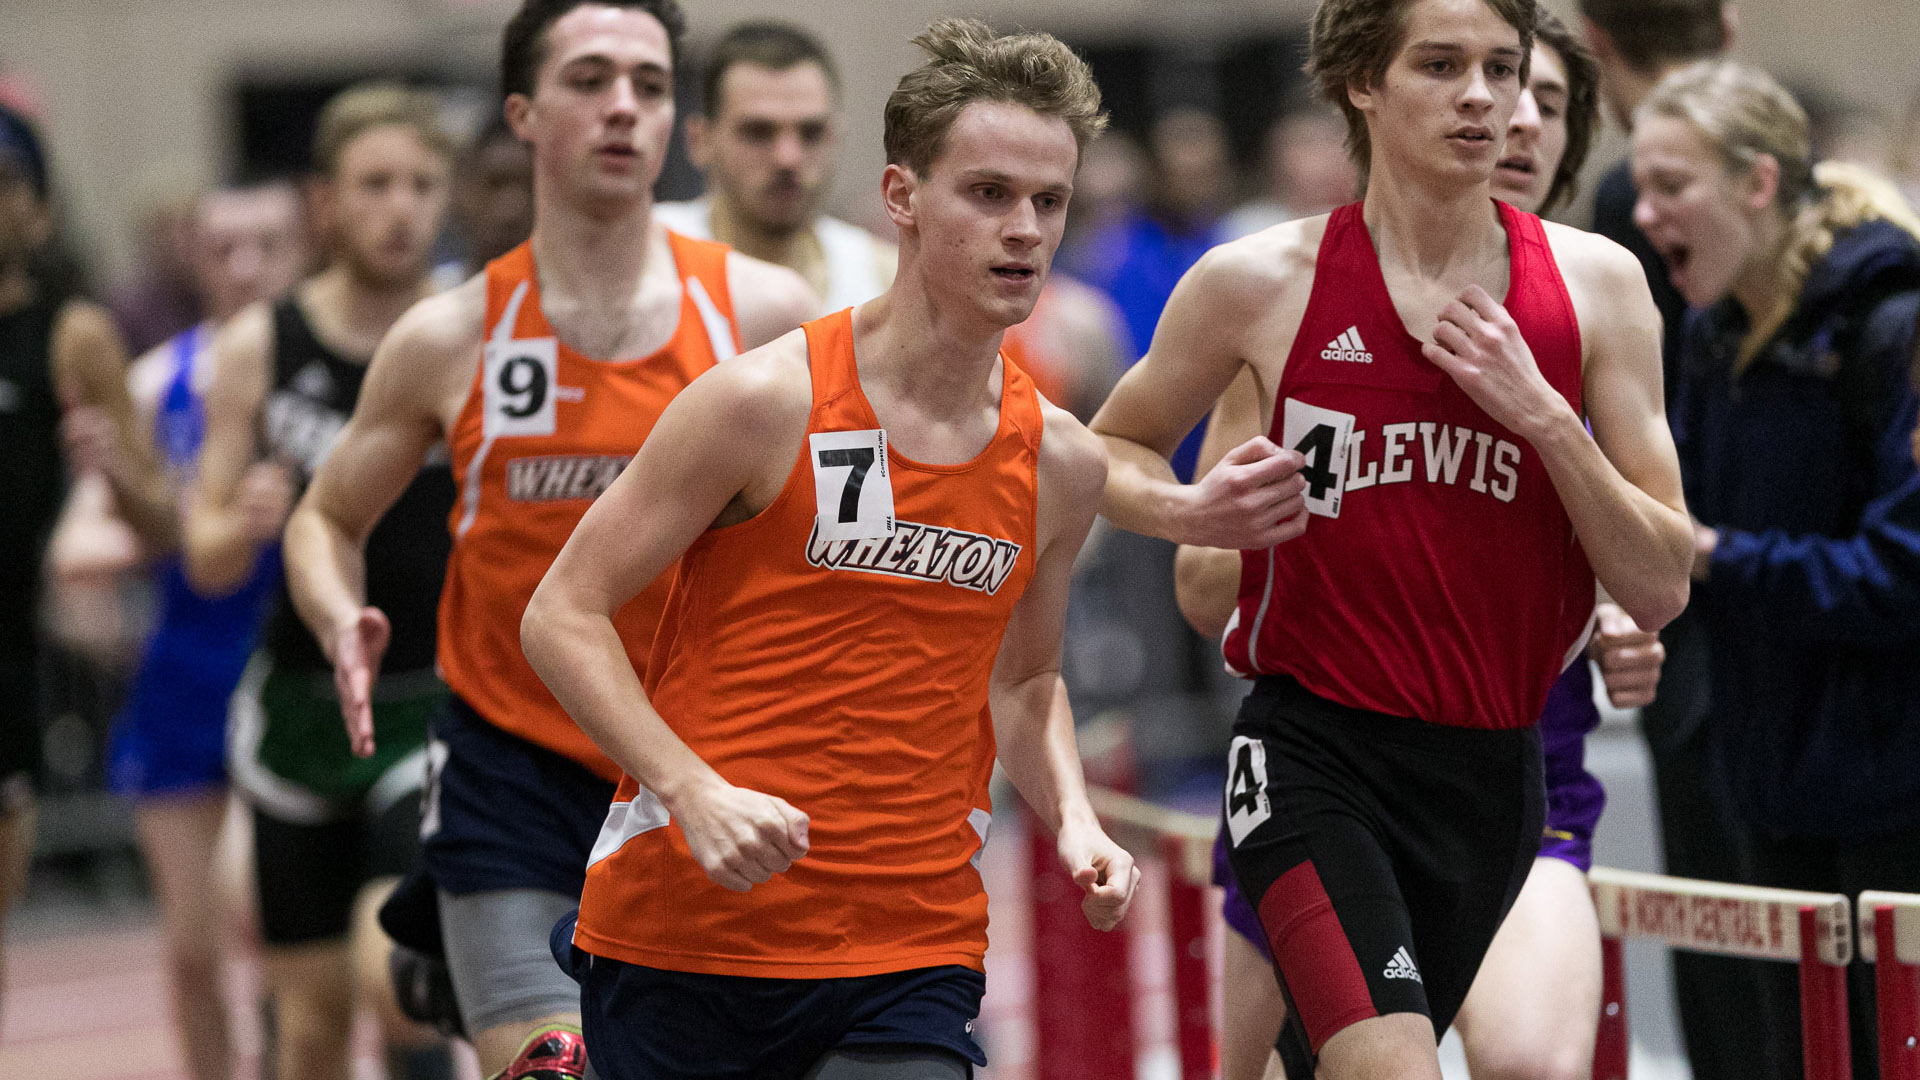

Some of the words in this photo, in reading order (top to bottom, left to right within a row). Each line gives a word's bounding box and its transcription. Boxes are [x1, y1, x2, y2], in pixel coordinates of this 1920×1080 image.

[498, 355, 547, 420] 9
[1320, 348, 1373, 363] adidas
[818, 447, 875, 524] 7
[1294, 423, 1337, 501] 4
[1344, 421, 1521, 503] LEWIS
[1230, 743, 1263, 819] 4
